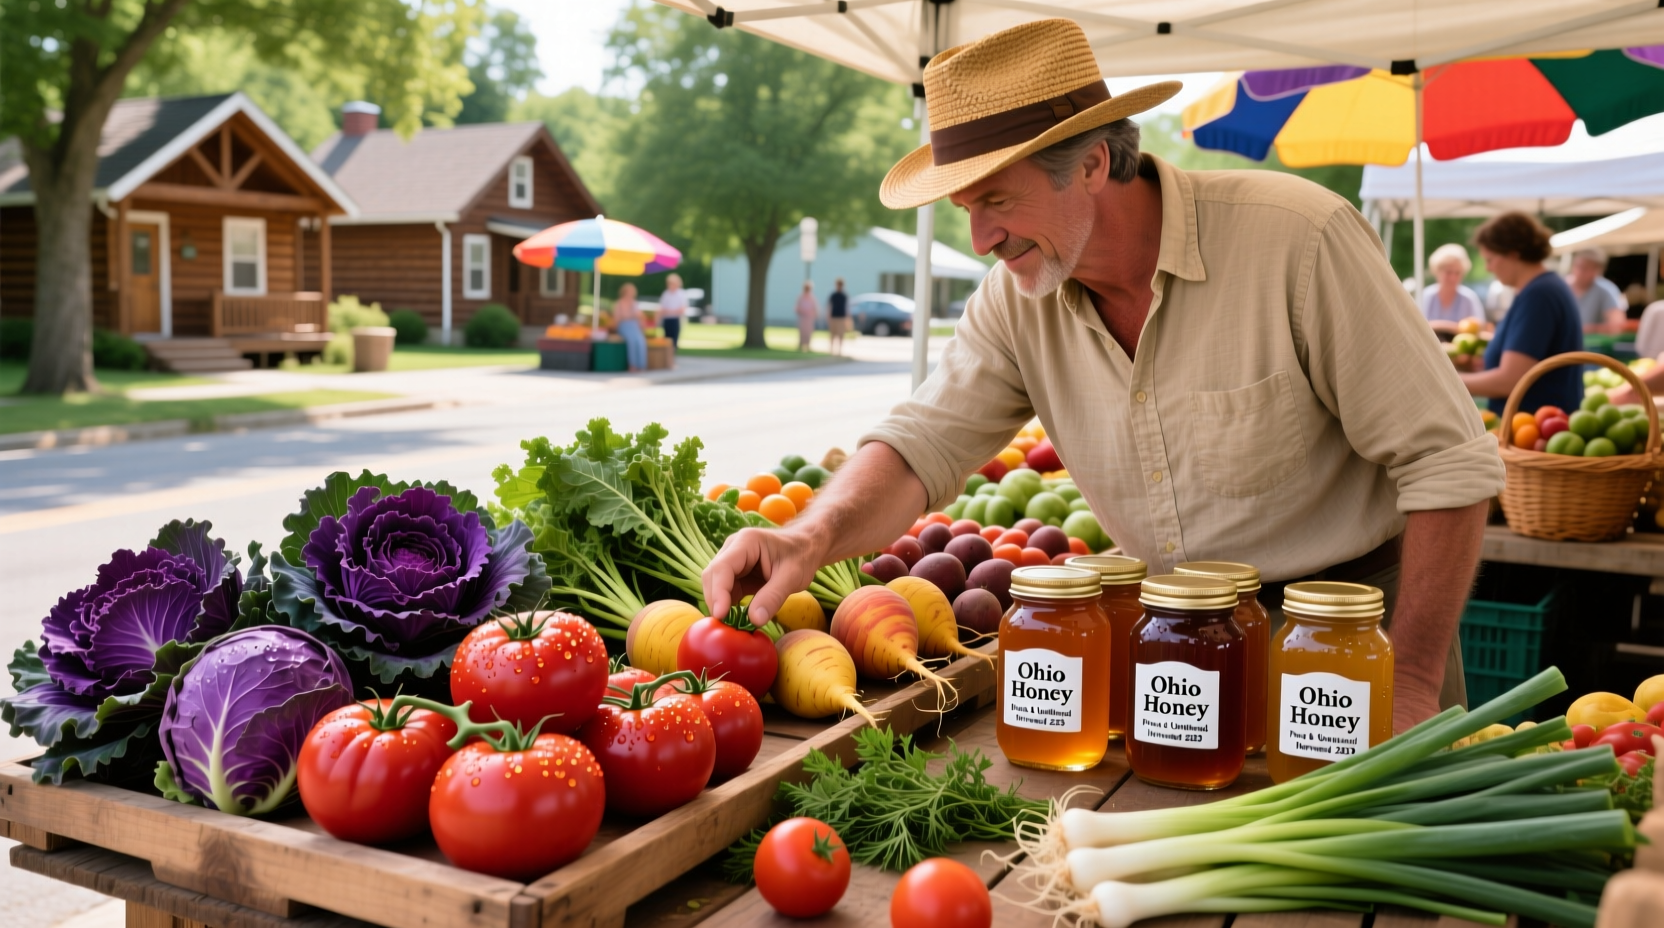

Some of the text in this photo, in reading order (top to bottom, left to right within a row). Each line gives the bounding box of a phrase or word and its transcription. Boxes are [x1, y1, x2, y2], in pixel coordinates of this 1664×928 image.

[1018, 662, 1066, 682] Ohio
[1012, 680, 1073, 706] Honey
[1151, 675, 1201, 696] Ohio
[1299, 686, 1352, 708] Ohio
[1144, 694, 1209, 721] Honey
[1290, 705, 1360, 734] Honey
